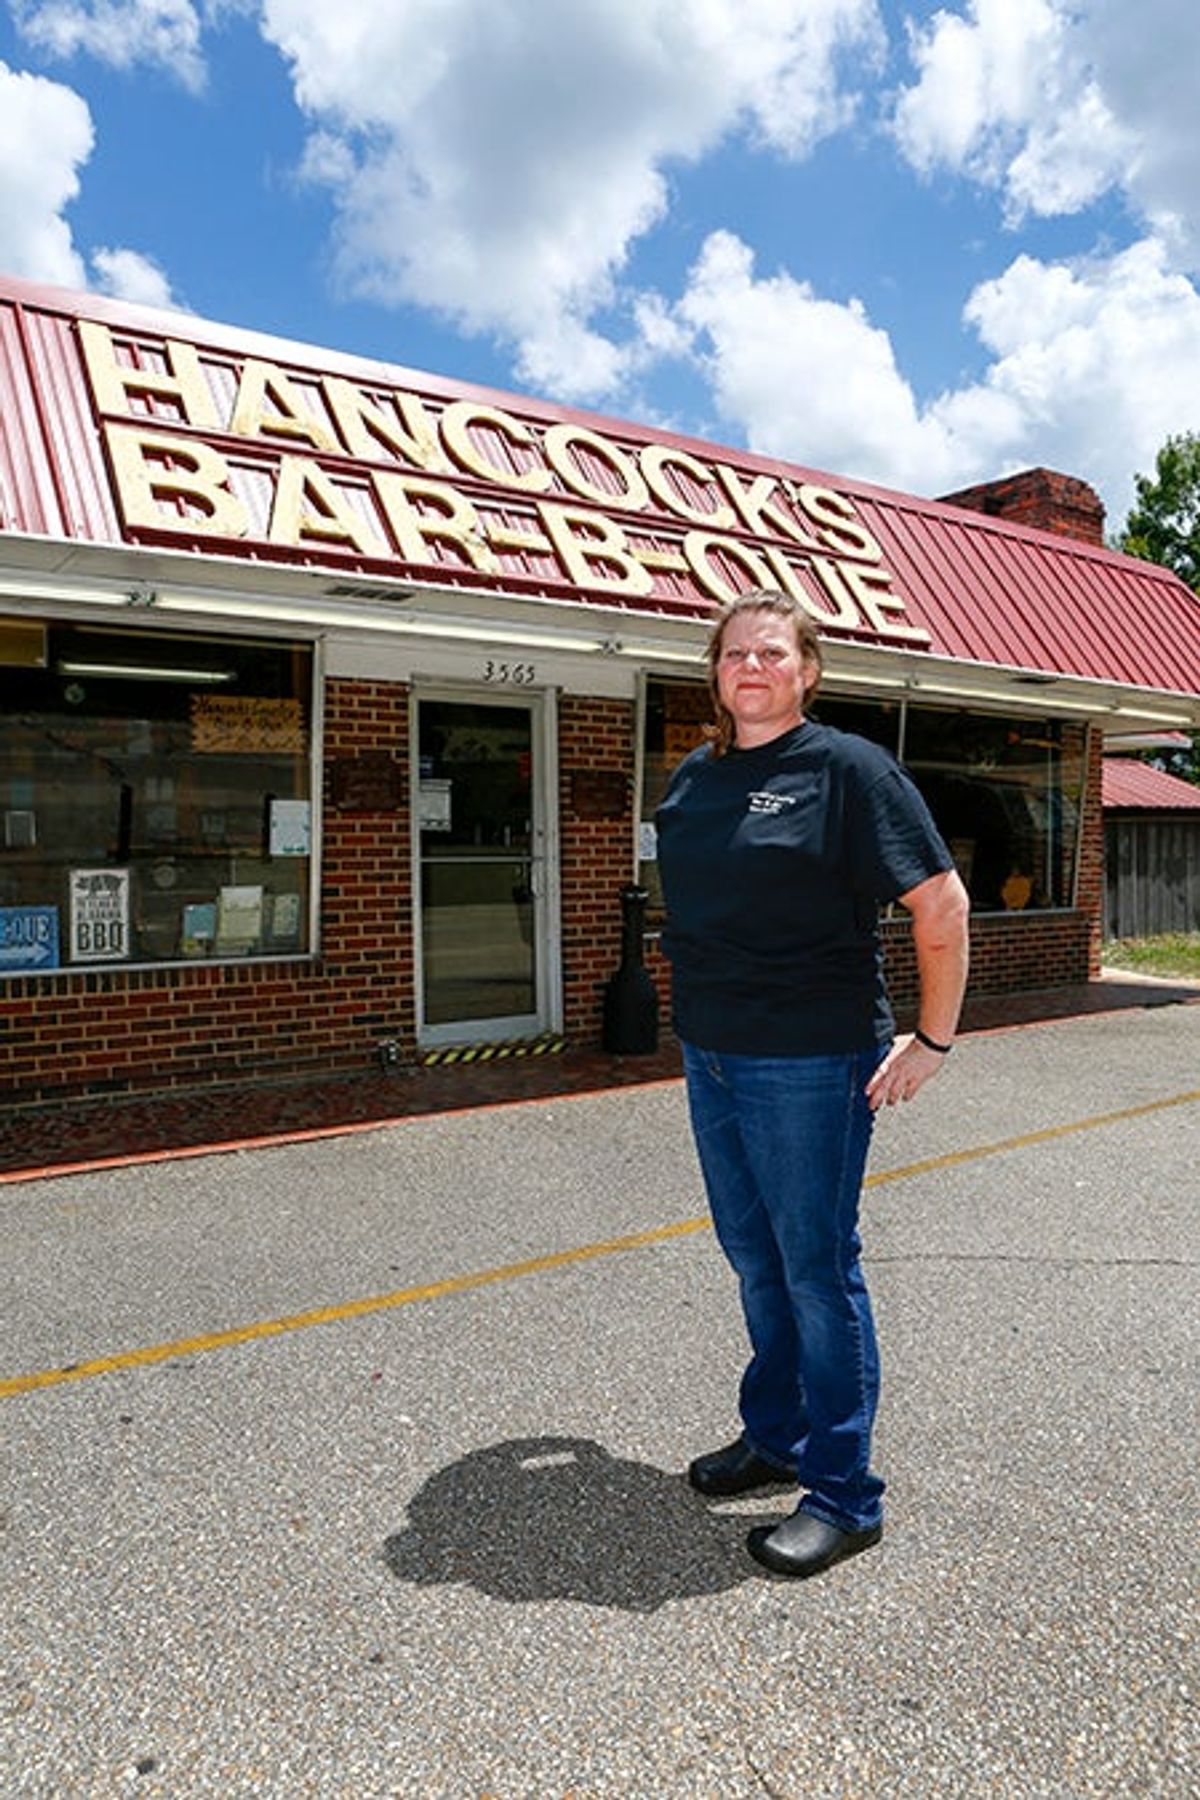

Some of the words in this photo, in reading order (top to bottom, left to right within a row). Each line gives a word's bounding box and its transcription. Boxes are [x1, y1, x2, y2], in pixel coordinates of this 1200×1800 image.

[78, 320, 883, 563] HANCOCK'S
[104, 421, 931, 642] BAR-B-QUE
[483, 661, 535, 684] 3565
[77, 920, 124, 953] BBQ
